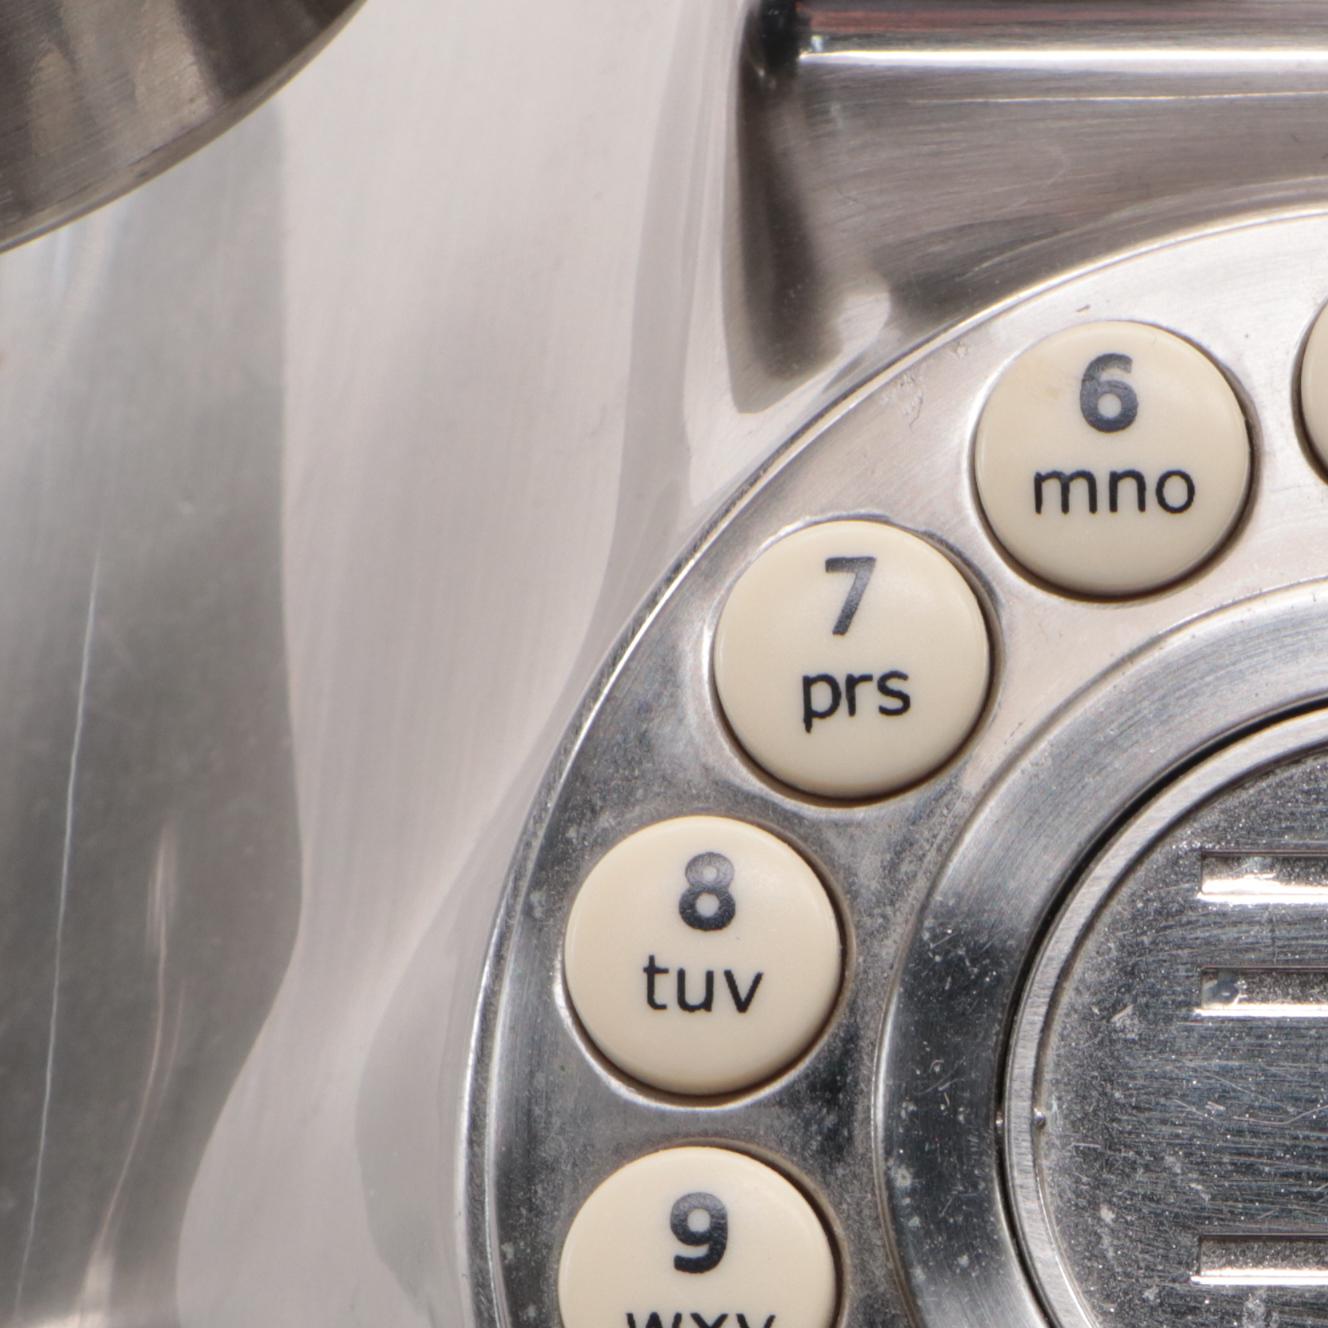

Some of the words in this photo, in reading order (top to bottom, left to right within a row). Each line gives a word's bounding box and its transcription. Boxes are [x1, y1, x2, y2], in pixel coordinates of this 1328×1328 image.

[1079, 351, 1139, 434] 6
[1033, 468, 1196, 515] mno
[825, 555, 877, 636] 7
[802, 669, 911, 735] prs
[678, 850, 736, 933] 8
[643, 954, 764, 1014] tuv
[669, 1191, 729, 1275] 9
